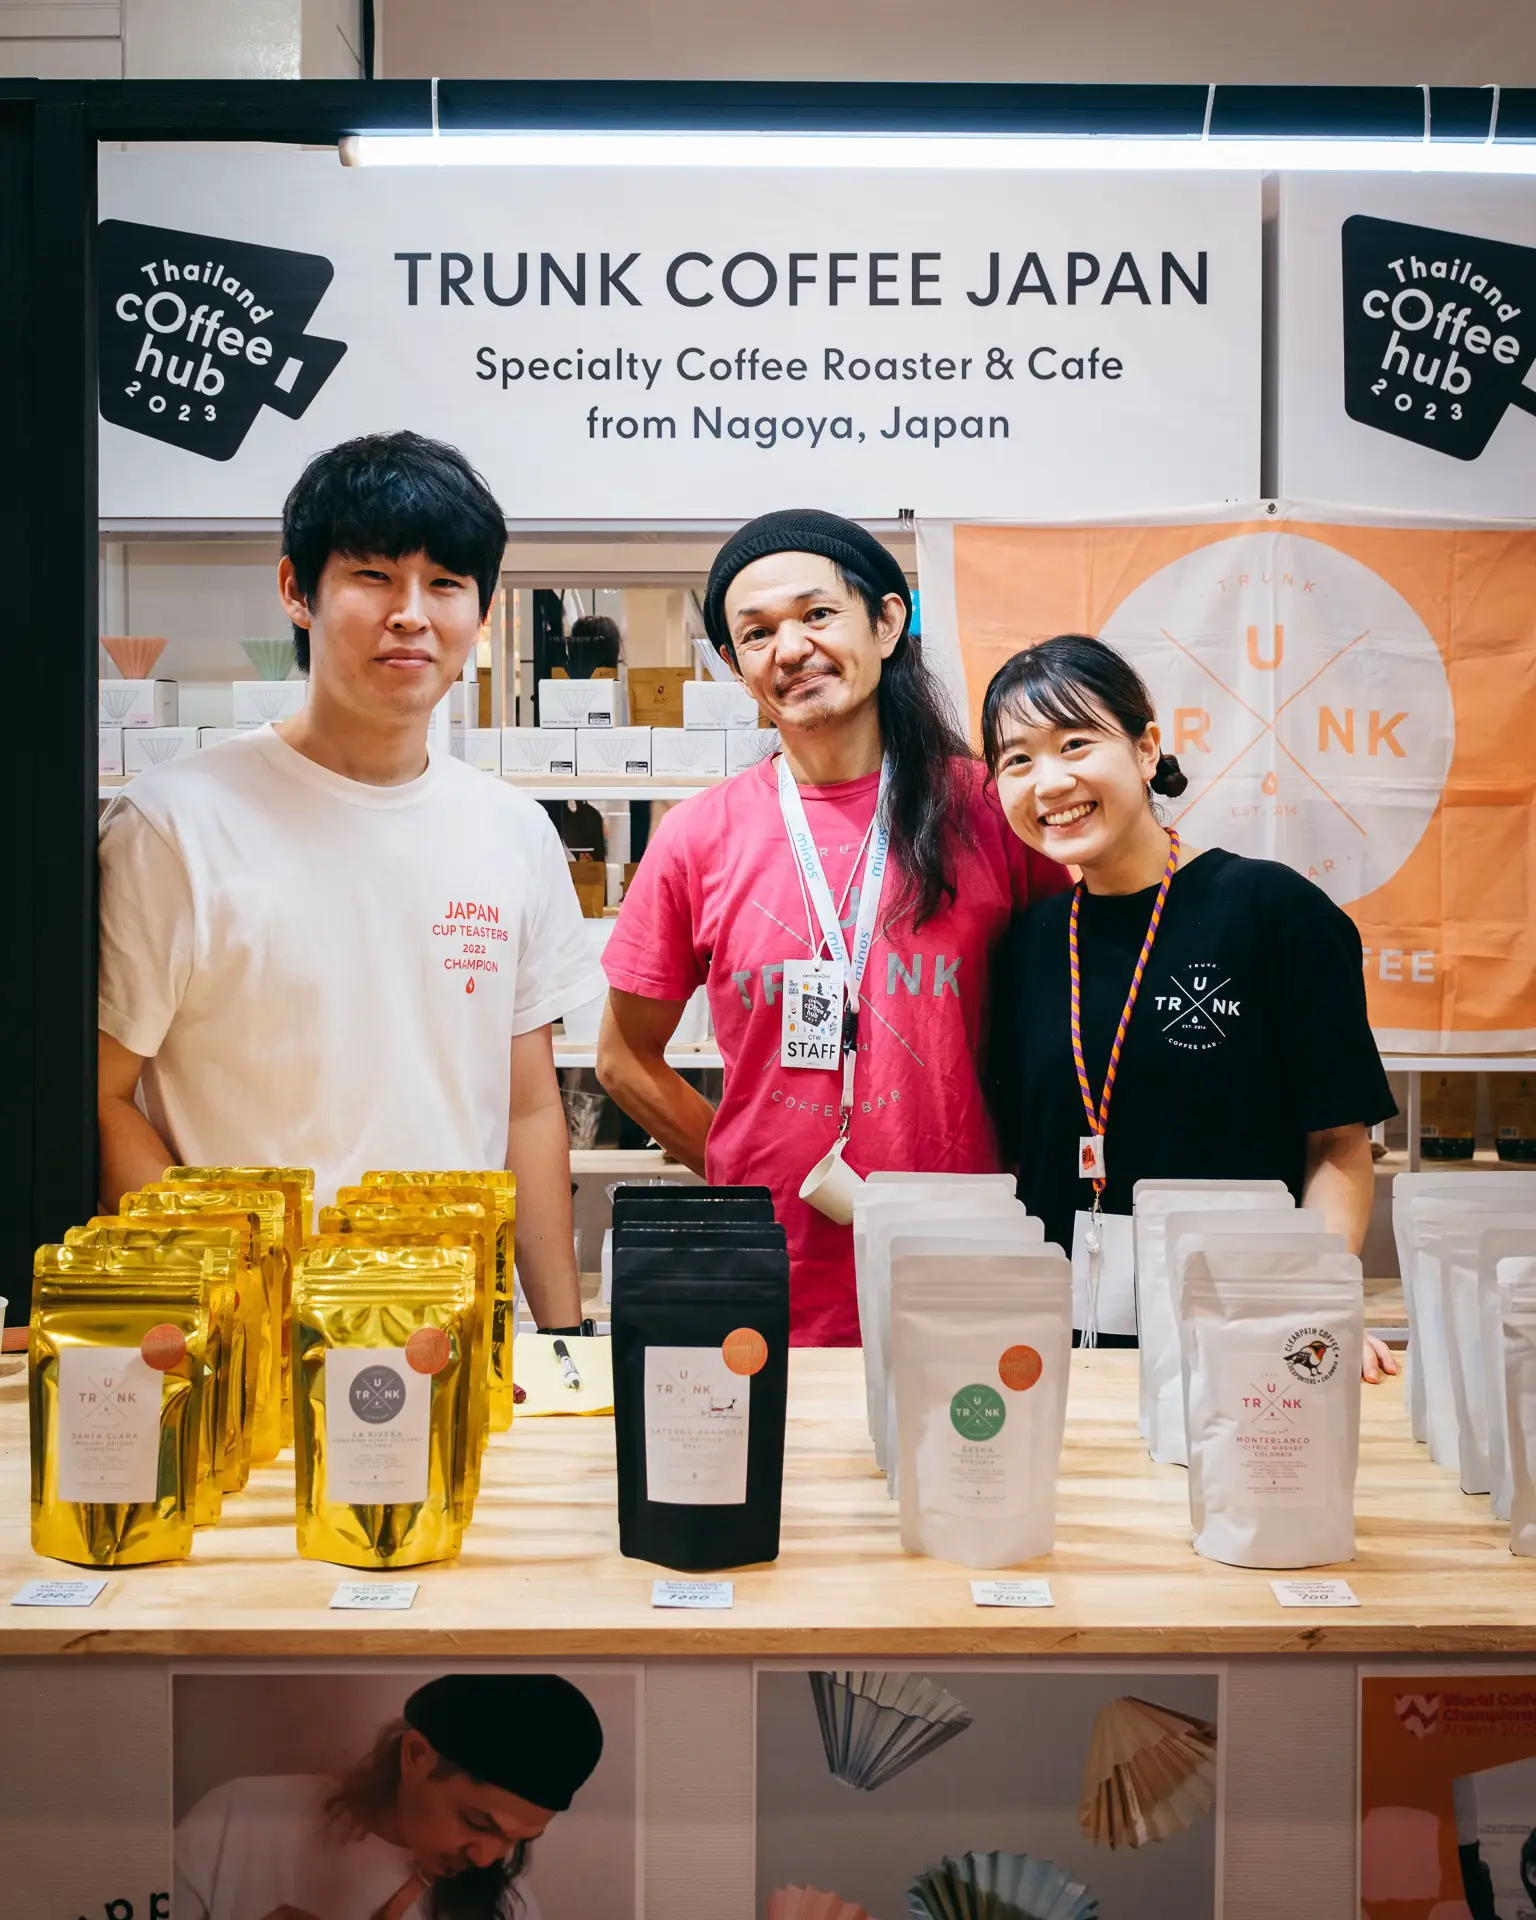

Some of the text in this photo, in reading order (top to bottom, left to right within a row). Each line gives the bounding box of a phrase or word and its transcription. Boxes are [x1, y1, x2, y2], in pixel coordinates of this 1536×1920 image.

[141, 259, 274, 324] Thailand
[395, 252, 1207, 307] TRUNK COFFEE JAPAN
[1388, 256, 1522, 323] Thailand
[135, 333, 225, 396] hub
[476, 347, 1122, 390] Specialty Coffee Roaster & Cafe
[1381, 330, 1472, 394] hub
[125, 381, 217, 421] 2023
[1371, 378, 1463, 420] 2023
[587, 406, 1008, 448] from Nagoya, Japan
[1217, 572, 1317, 592] TRUNK
[1174, 705, 1410, 758] R NK
[1231, 804, 1297, 817] EST. 2014
[796, 832, 818, 880] minos
[1307, 858, 1337, 879] AR
[445, 901, 499, 923] JAPAN
[432, 924, 509, 942] CUP TEASTERS
[827, 931, 843, 961] min
[463, 944, 487, 954] 2022
[855, 932, 870, 981] minos
[444, 958, 499, 973] CHAMPION
[1155, 996, 1241, 1016] TR NK
[787, 1041, 836, 1060] STAFF
[1168, 1038, 1216, 1050] COFFEE BAR
[862, 1089, 902, 1113] BAR
[1285, 1327, 1340, 1352] CLEARPATH COFFEE
[1236, 1436, 1310, 1444] MONTEBLANCO
